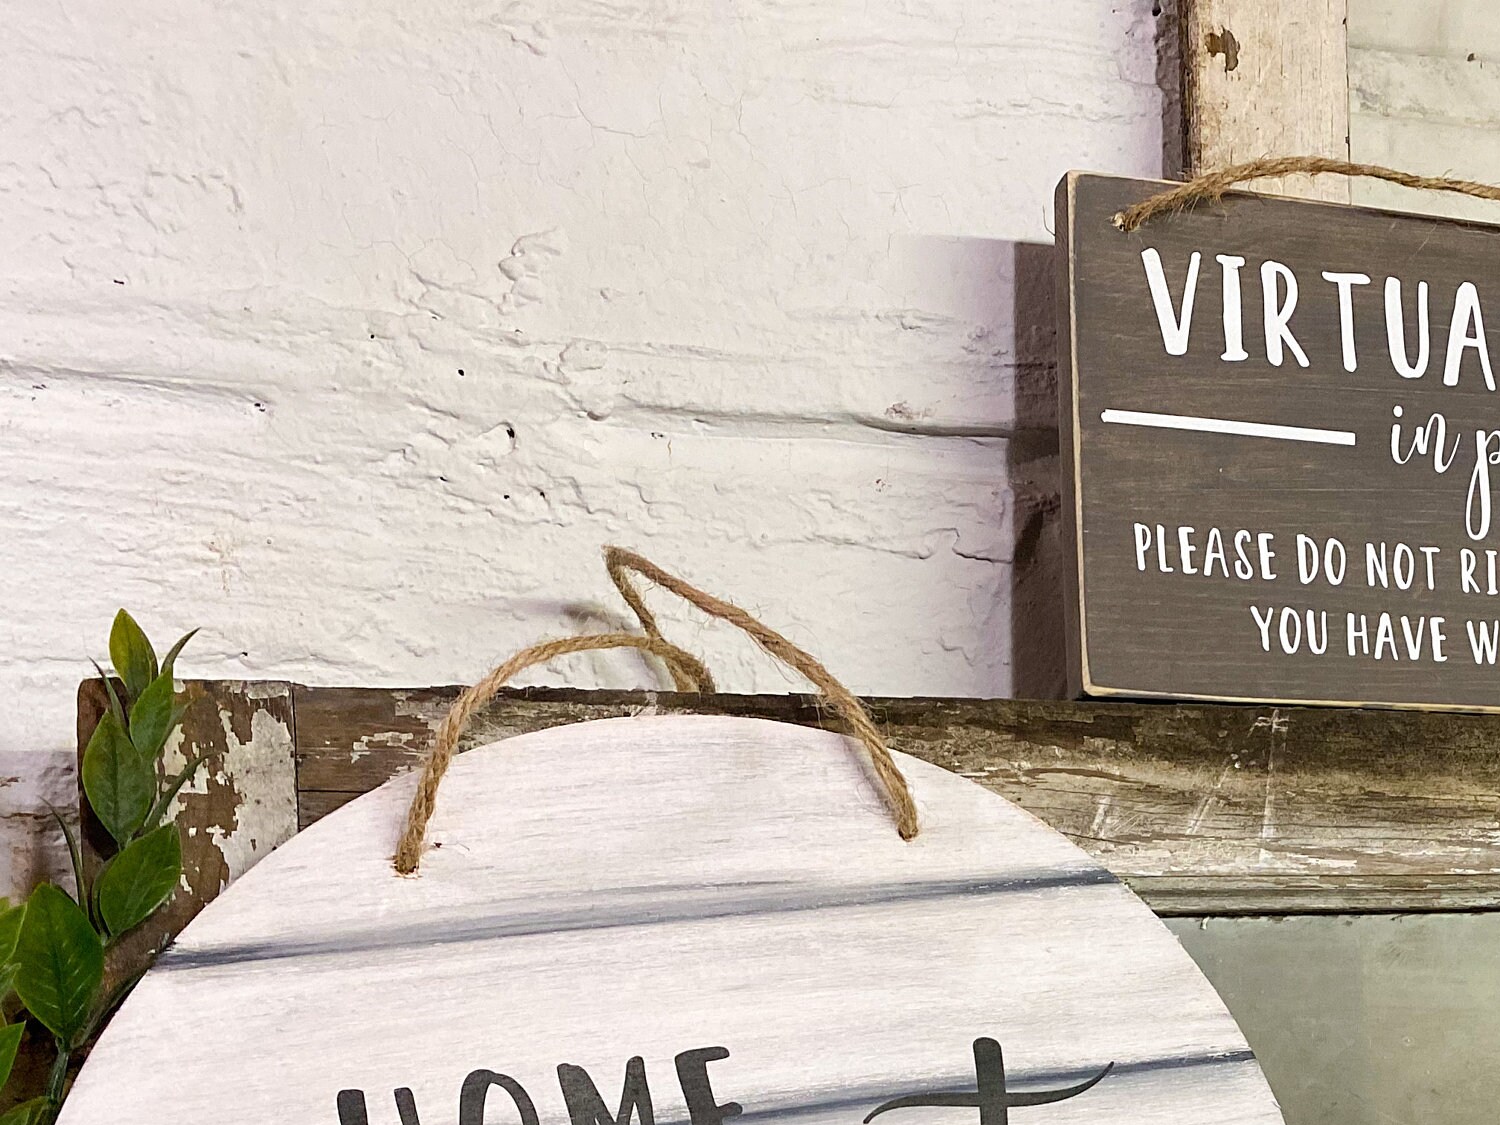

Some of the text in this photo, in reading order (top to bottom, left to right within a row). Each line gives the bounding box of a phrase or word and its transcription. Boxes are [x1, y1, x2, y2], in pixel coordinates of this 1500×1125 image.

[1390, 405, 1461, 474] in
[1133, 522, 1277, 581] PLEASE
[1296, 533, 1347, 587] DO
[1365, 541, 1441, 592] NOT
[1249, 605, 1328, 656] YOU
[1346, 612, 1448, 663] HAVE
